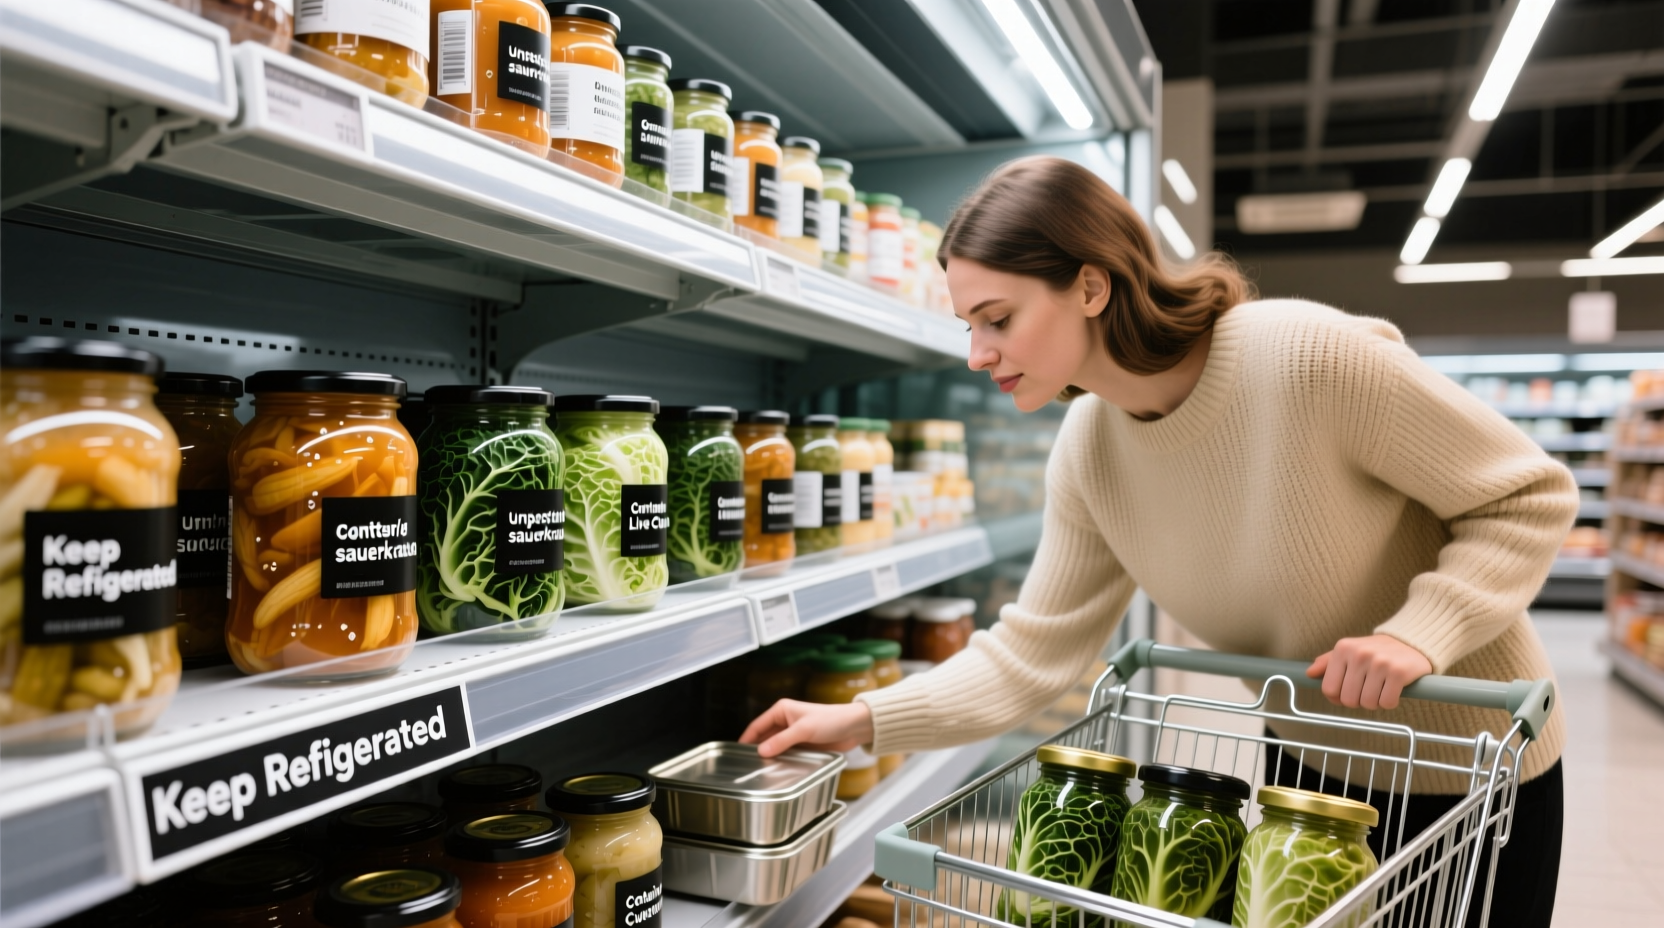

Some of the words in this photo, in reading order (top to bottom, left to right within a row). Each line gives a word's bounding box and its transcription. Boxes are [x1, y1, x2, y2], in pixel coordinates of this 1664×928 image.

[42, 534, 121, 571] Keep
[151, 772, 258, 835] Keep
[263, 704, 447, 797] Refigerated
